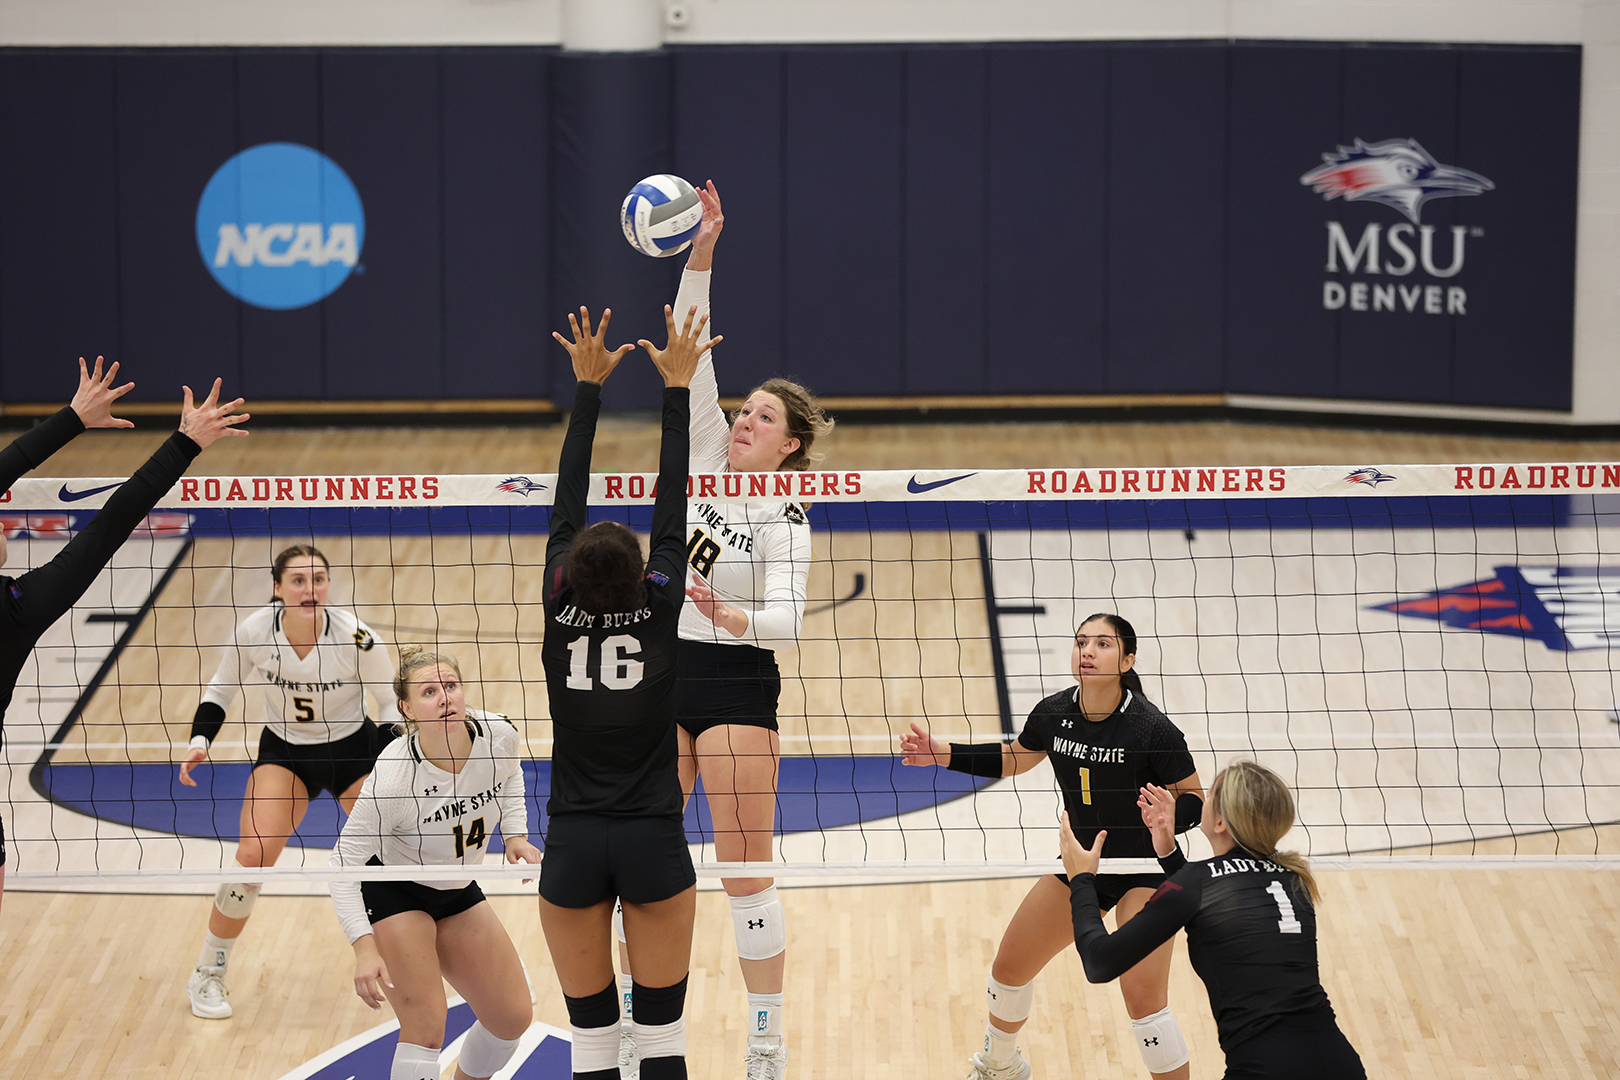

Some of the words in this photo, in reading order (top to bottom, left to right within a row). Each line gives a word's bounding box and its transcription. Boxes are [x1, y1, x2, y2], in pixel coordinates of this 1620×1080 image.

[214, 223, 359, 267] NCAA
[1325, 220, 1467, 278] MSU
[1322, 280, 1468, 315] DENVER
[180, 476, 439, 501] ROADRUNNERS
[604, 472, 862, 499] RORUNNERS
[1027, 467, 1286, 494] ROADRUNNERS
[1454, 465, 1620, 490] ROADRUN
[687, 527, 722, 580] 18
[555, 604, 596, 629] LADY
[602, 606, 652, 629] BUFFS
[566, 633, 645, 691] 16
[293, 696, 316, 724] 5
[1053, 735, 1089, 760] WAYNE
[1089, 745, 1125, 764] STATE
[1079, 766, 1092, 805] 1
[452, 816, 487, 859] 14
[1207, 858, 1260, 878] LADY
[1265, 880, 1302, 934] 1
